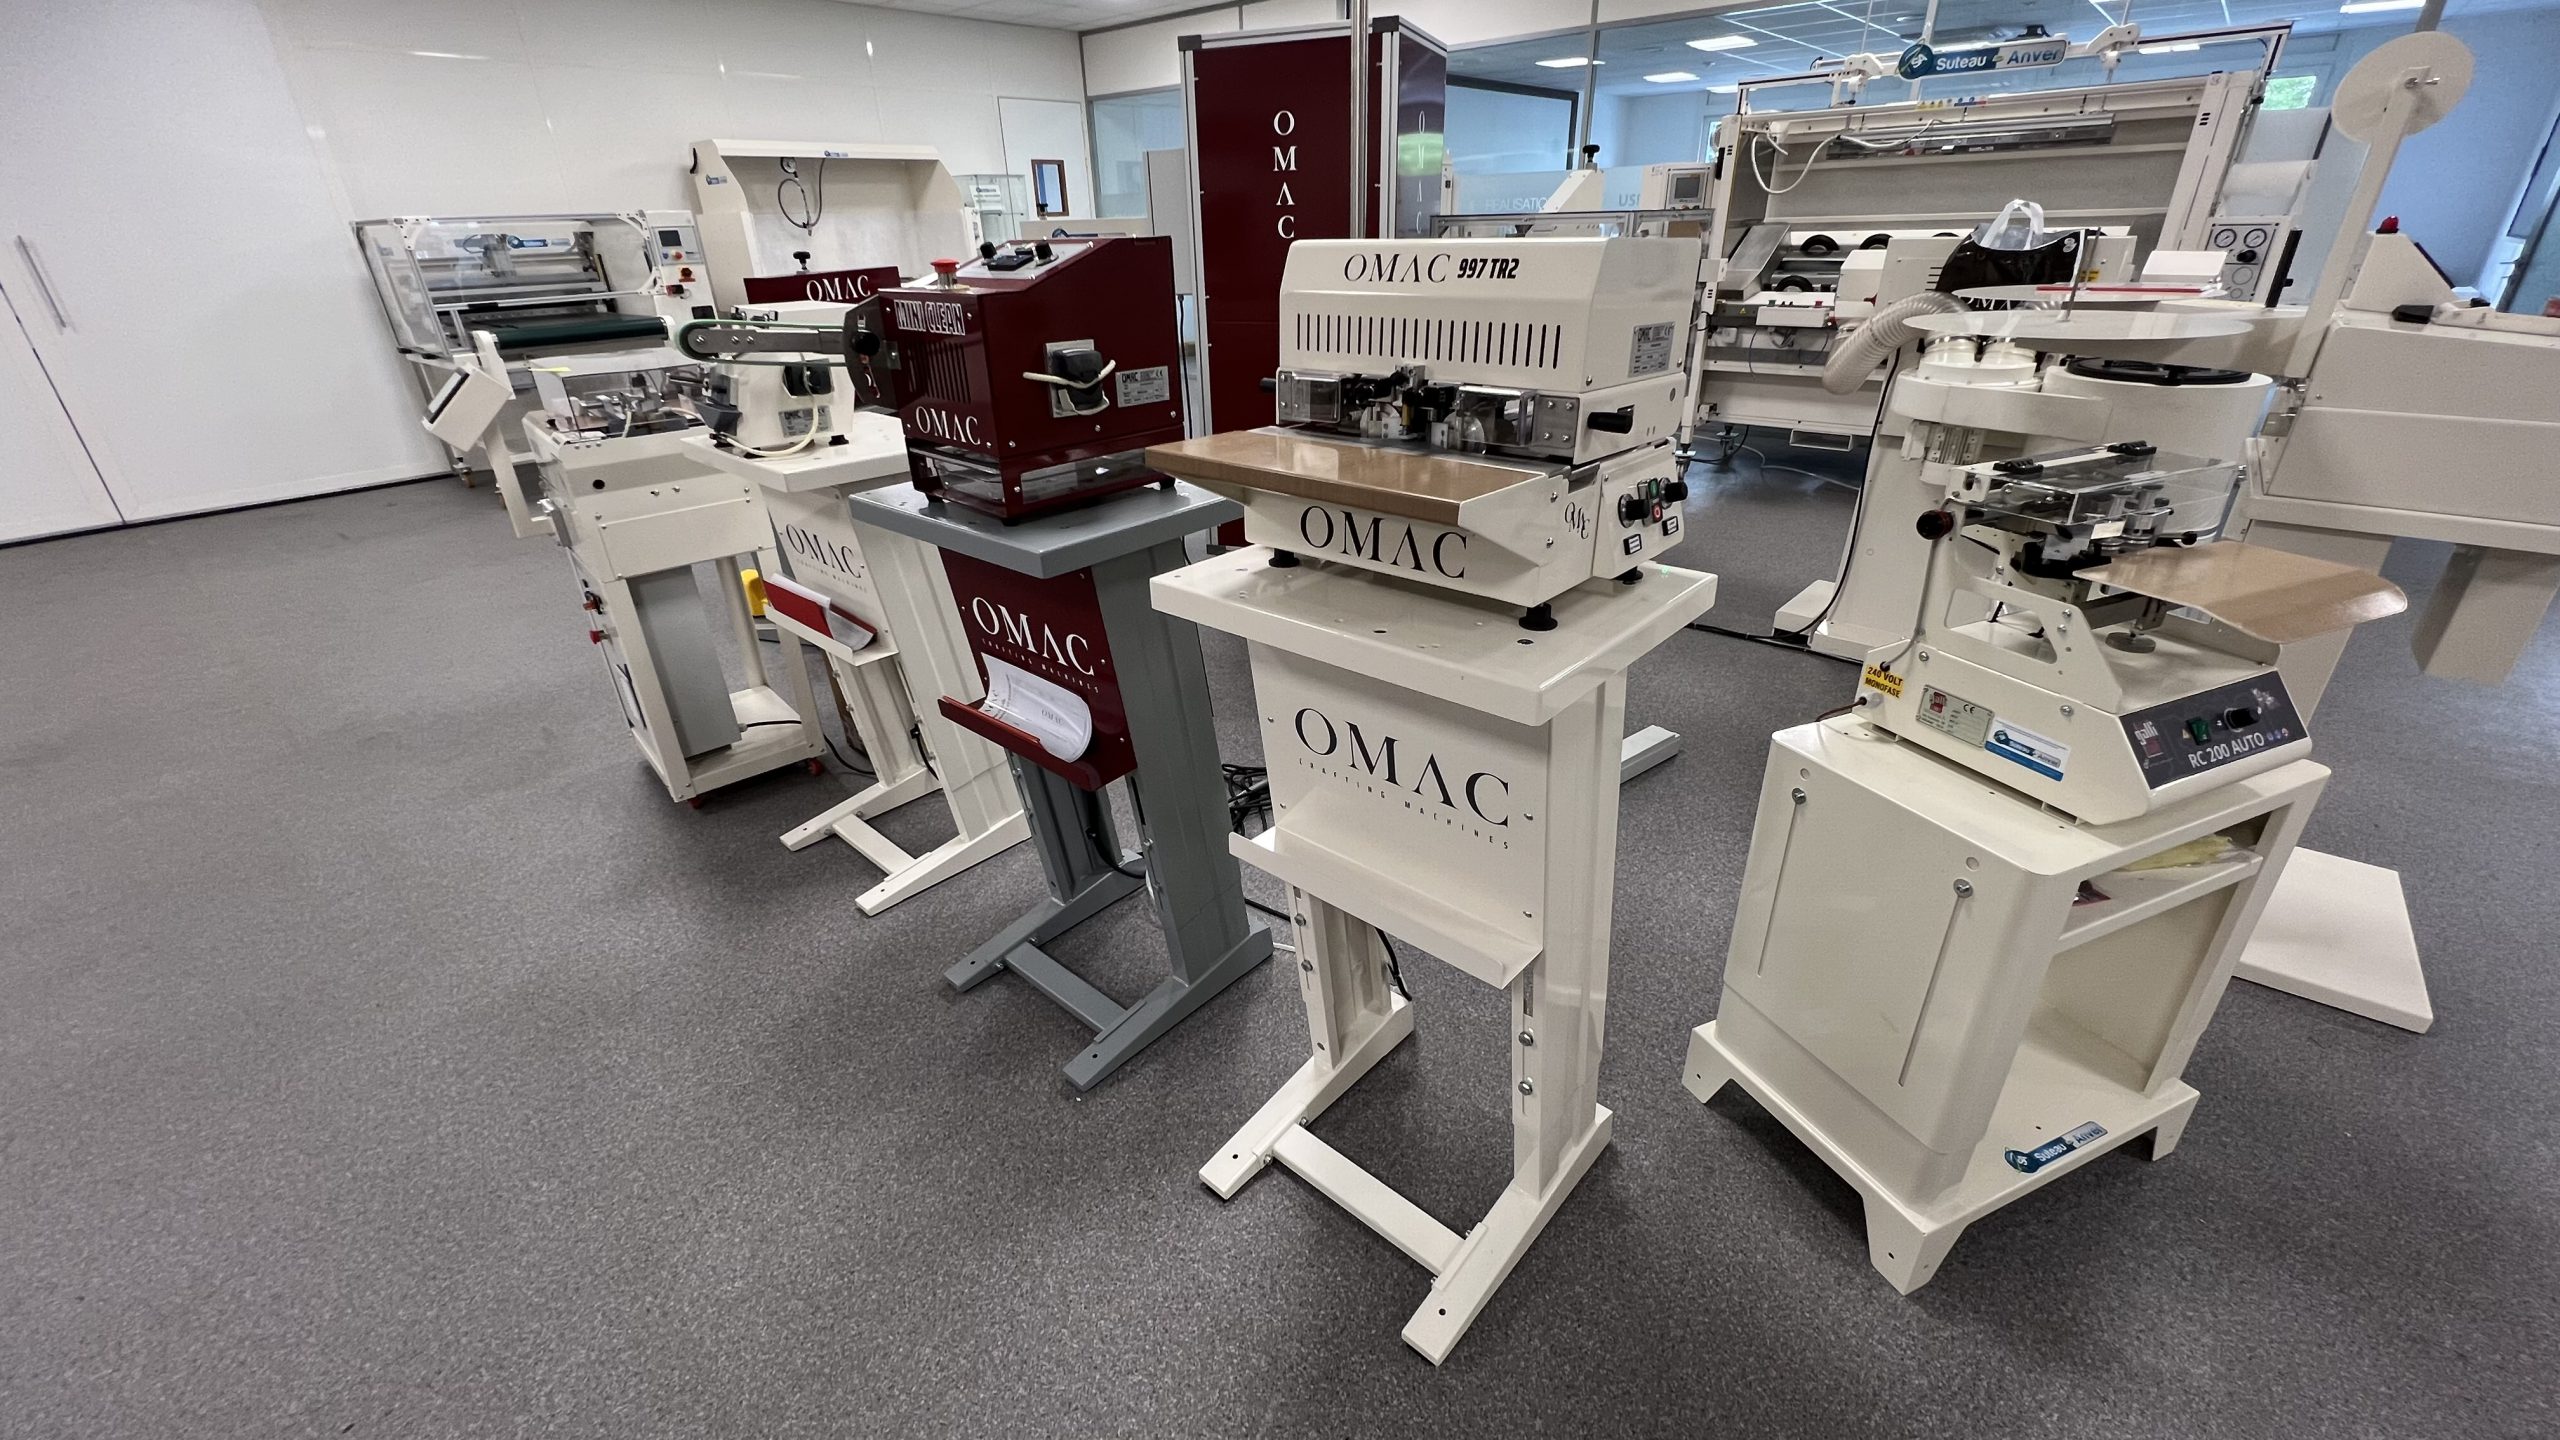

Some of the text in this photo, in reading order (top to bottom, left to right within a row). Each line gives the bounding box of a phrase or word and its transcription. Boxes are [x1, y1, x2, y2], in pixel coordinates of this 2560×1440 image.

[1936, 55, 1987, 71] Suteau
[2007, 49, 2059, 65] Anver
[1272, 110, 1297, 239] OMAC
[1344, 253, 1520, 283] OMAC 997 TR2
[806, 275, 871, 302] OMAC
[894, 299, 966, 337] MINI CLEAN
[915, 406, 981, 446] OMAC
[786, 523, 861, 579] OMAC
[1300, 505, 1467, 580] OMAC
[972, 596, 1095, 677] OMAC
[1865, 677, 1901, 699] MONOFASE
[1868, 666, 1903, 687] 240 VOLT
[1294, 707, 1509, 828] OMAC
[2188, 750, 2207, 769] RC
[2206, 743, 2230, 763] 200
[2231, 732, 2265, 755] AUTO
[1404, 800, 1509, 850] MACHINES
[2033, 1143, 2068, 1162] Suteau
